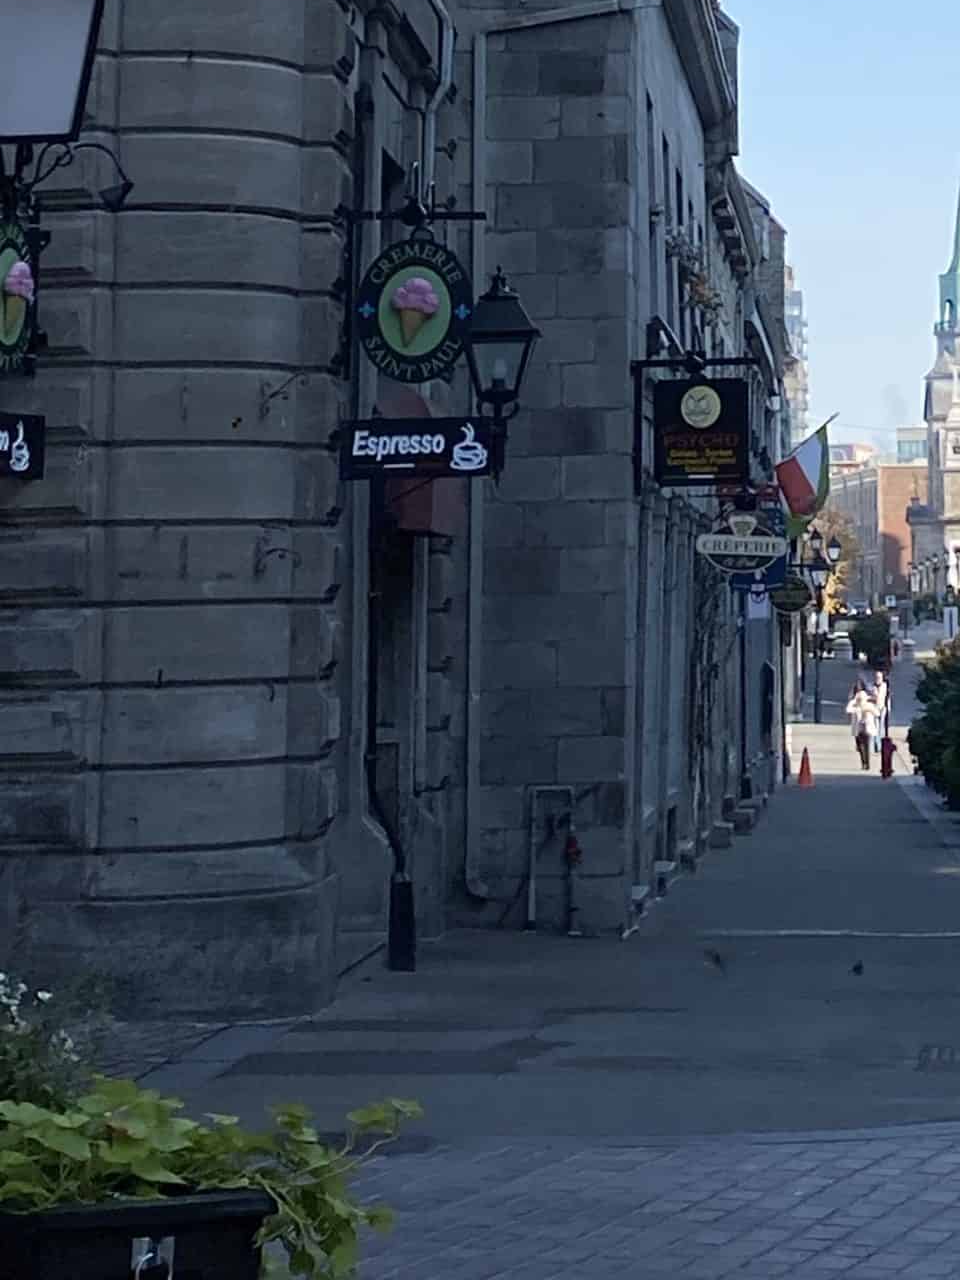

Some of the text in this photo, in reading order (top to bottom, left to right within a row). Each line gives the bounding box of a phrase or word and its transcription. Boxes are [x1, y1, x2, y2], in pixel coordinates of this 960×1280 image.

[365, 336, 464, 378] SAINT PAUL
[352, 429, 446, 462] Espresso
